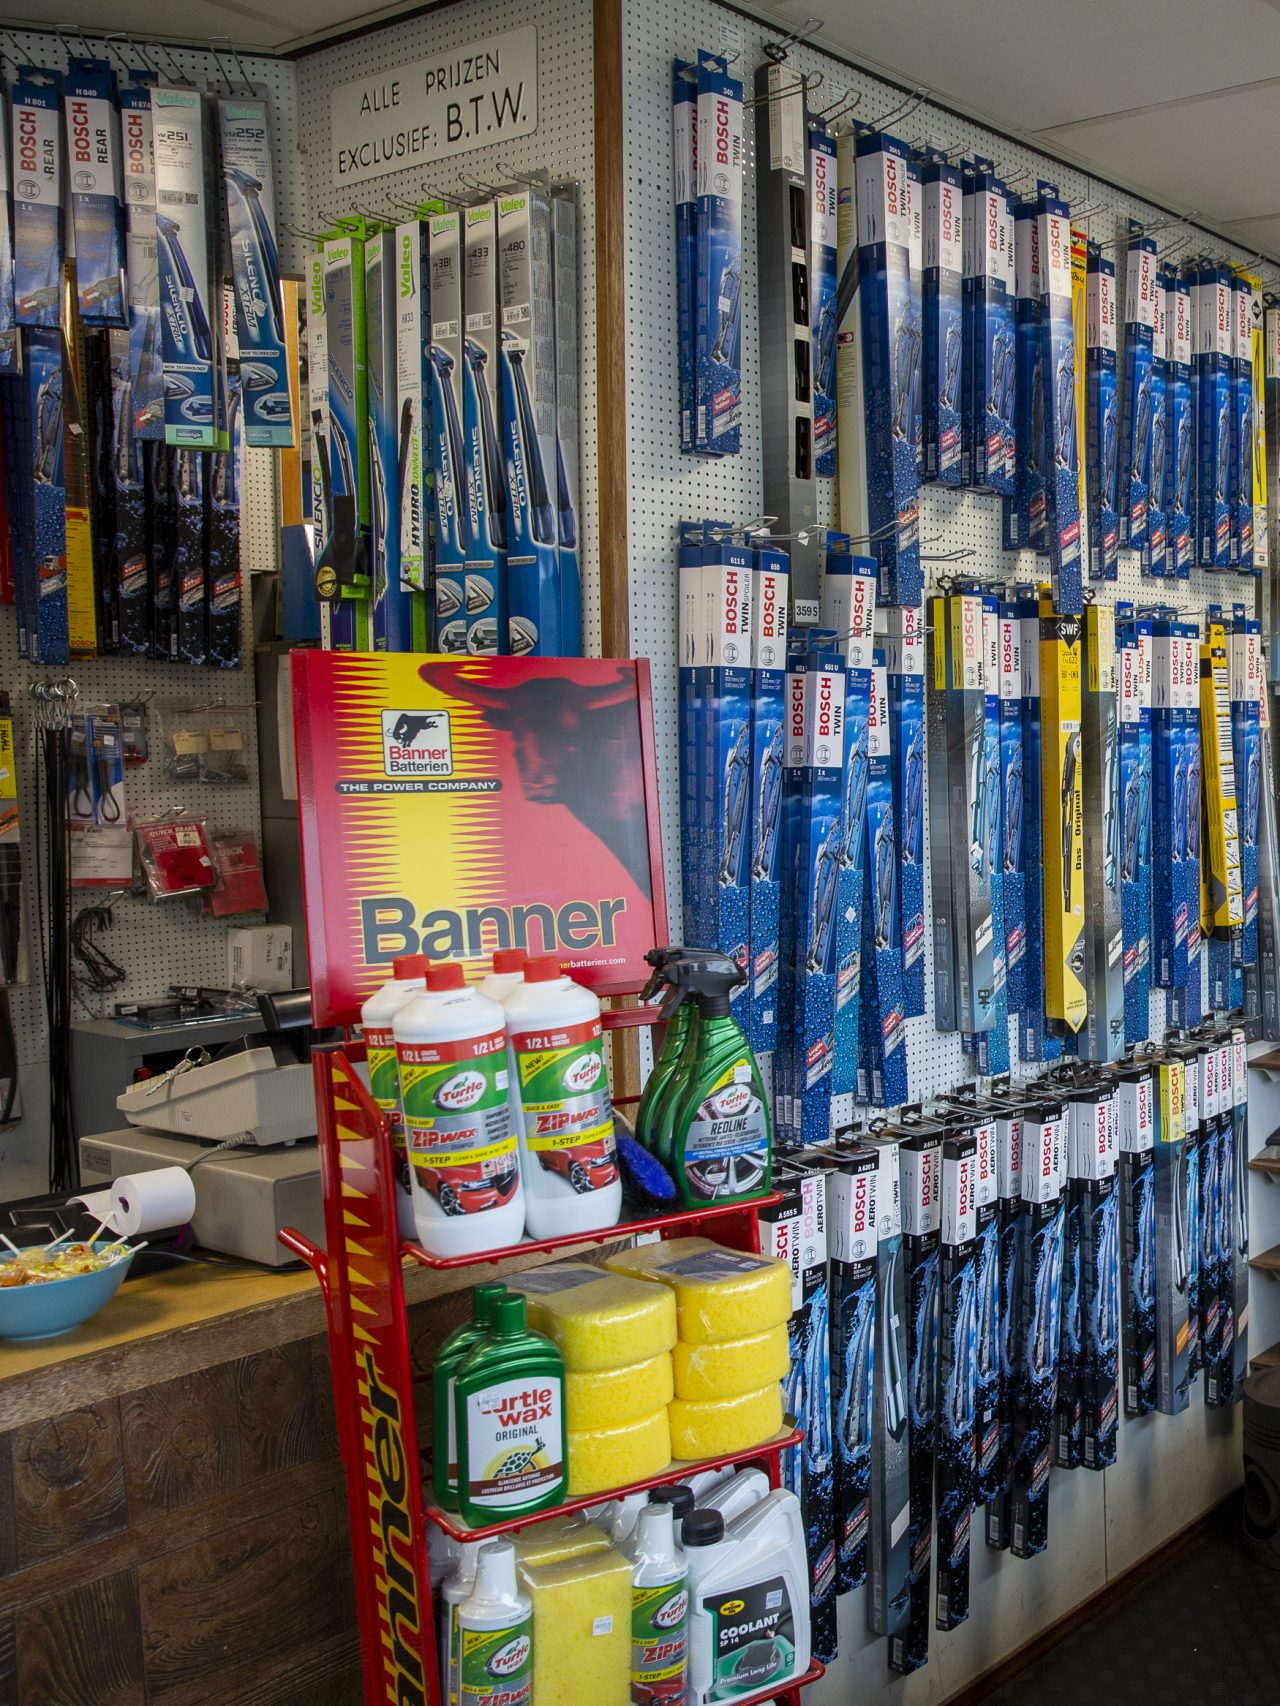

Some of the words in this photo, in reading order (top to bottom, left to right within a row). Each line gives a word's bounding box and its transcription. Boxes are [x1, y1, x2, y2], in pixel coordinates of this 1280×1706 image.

[83, 89, 97, 97] 840
[360, 81, 400, 117] ALLE
[426, 49, 501, 96] PRIJZEN
[723, 87, 733, 97] 340
[156, 91, 196, 107] Valeo
[226, 106, 262, 120] Valeo
[447, 81, 529, 143] B.T.W.
[20, 110, 37, 172] BOSCH
[128, 114, 145, 174] BOSCH
[167, 131, 188, 142] 251
[236, 127, 265, 139] 252
[43, 139, 55, 175] REAR
[96, 129, 108, 163] REAR
[732, 134, 741, 167] TWIN
[816, 156, 826, 215] BOSCH
[467, 208, 492, 223] Valeo
[500, 198, 526, 214] Valeo
[942, 187, 952, 242] BOSCH
[432, 218, 456, 233] Valeo
[327, 247, 349, 262] Valeo
[471, 247, 489, 259] 433
[507, 240, 526, 252] 480
[1050, 218, 1060, 270] BOSCH
[401, 235, 411, 298] Valeo
[1141, 255, 1149, 301] BOSCH
[311, 261, 322, 315] Valeo
[165, 275, 188, 335] SILENCIO
[471, 426, 485, 512] SILENCIO
[510, 421, 526, 508] SILENCIO
[312, 465, 324, 551] SILENCIO
[411, 484, 420, 549] HYDRO
[731, 556, 741, 565] 611
[770, 563, 780, 571] 650
[725, 571, 738, 635] BOSCH
[796, 604, 811, 617] 359
[812, 606, 818, 617] S
[853, 580, 865, 639] BOSCH
[777, 606, 785, 638] TWIN
[1060, 622, 1079, 635] SWF
[819, 677, 832, 737] BOSCH
[389, 746, 448, 760] Banner
[390, 761, 449, 773] Batterien
[340, 783, 368, 792] THE
[374, 782, 423, 792] POWER
[428, 781, 497, 791] COMPANY
[1074, 789, 1083, 837] Original
[1074, 845, 1083, 871] Das
[361, 896, 626, 965] Banner
[526, 1038, 543, 1049] 1/2
[525, 1056, 544, 1070] NEW!
[572, 1061, 601, 1084] Turtle
[443, 1081, 483, 1102] Turtle
[456, 1093, 475, 1106] wax
[720, 1091, 749, 1108] Turtle
[536, 1115, 569, 1134] ZIP
[710, 1117, 748, 1136] REDLINE
[412, 1130, 439, 1148] ZIP
[552, 1136, 581, 1146] 1-STEP
[423, 1156, 451, 1165] 1-STEP
[1042, 1126, 1052, 1177] BOSCH
[783, 1210, 793, 1218] 555
[854, 1177, 867, 1233] BOSCH
[792, 1220, 800, 1279] AEROTWIN
[478, 1387, 553, 1415] urtle
[498, 1404, 553, 1428] wax
[495, 1423, 539, 1443] ORIGINAL
[719, 1612, 780, 1640] COOLANT
[719, 1639, 729, 1647] SP
[731, 1637, 739, 1645] 14
[494, 1640, 530, 1670] Turtle
[638, 1671, 662, 1682] 1-STEP
[719, 1672, 749, 1685] Premium
[750, 1665, 766, 1676] Long
[766, 1661, 778, 1671] Life
